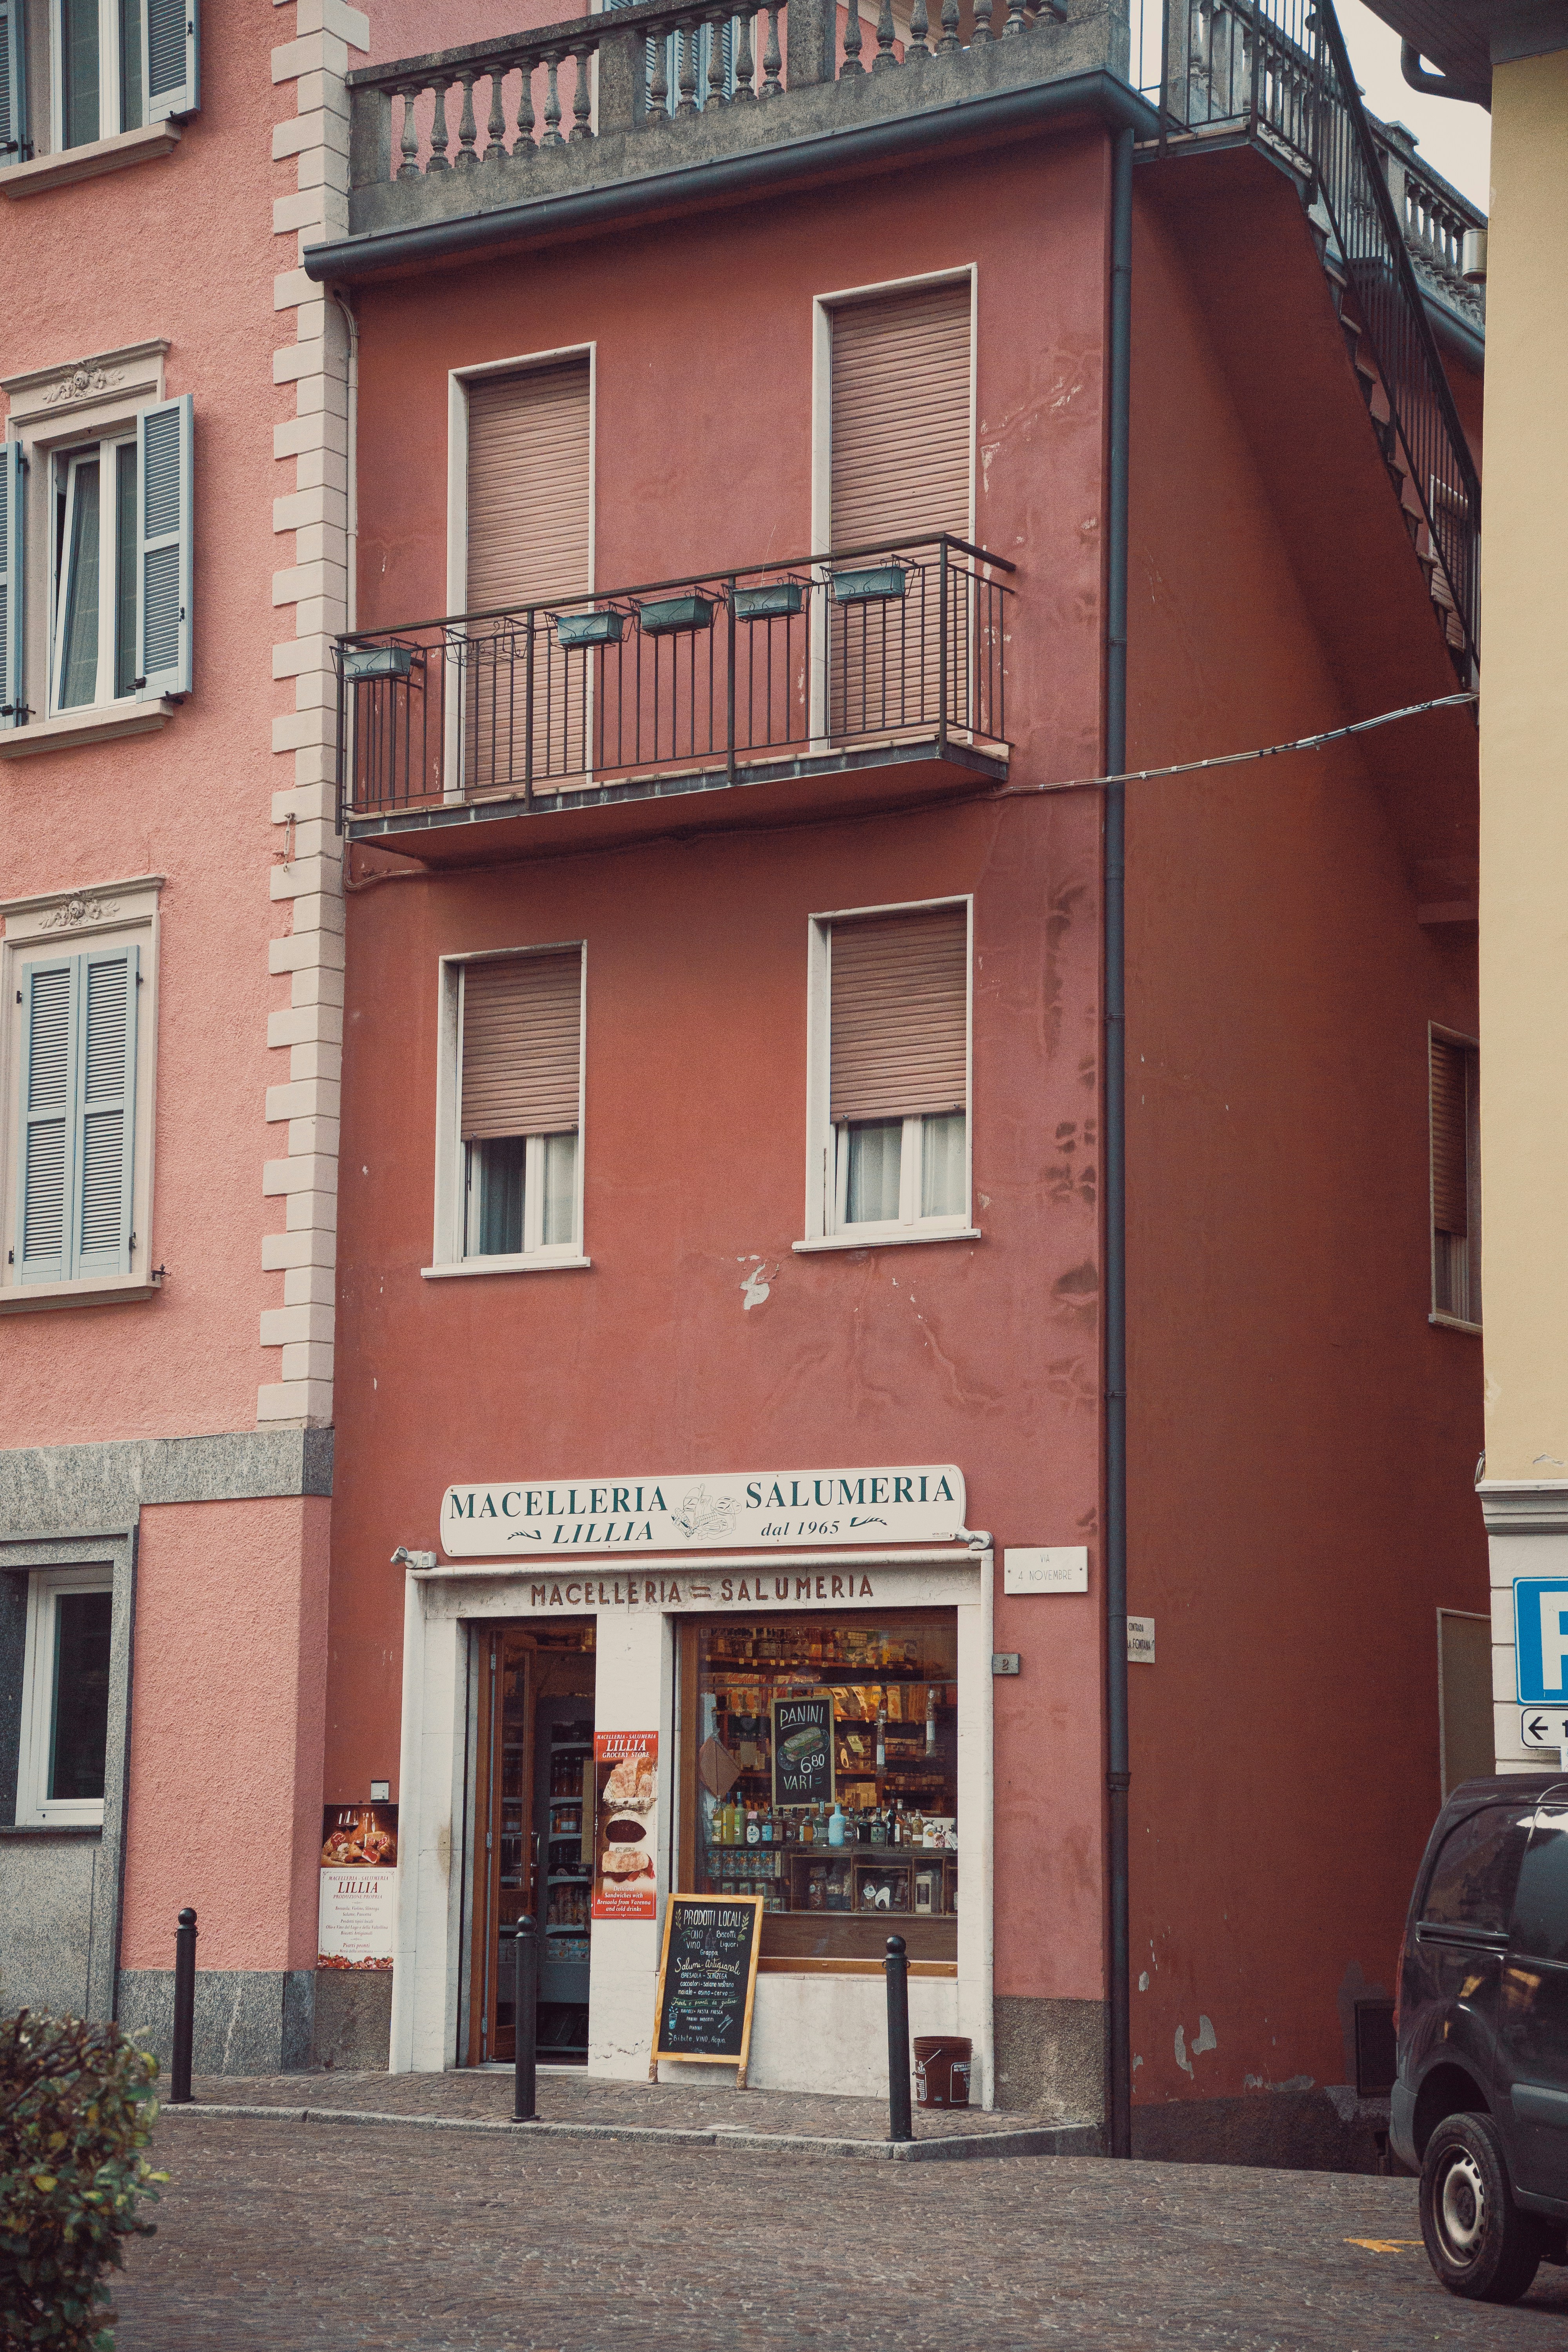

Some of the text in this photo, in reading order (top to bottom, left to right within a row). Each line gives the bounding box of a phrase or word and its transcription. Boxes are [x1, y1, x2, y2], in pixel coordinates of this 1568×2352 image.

[449, 1475, 955, 1519] MACELLERIA SALUMERIA
[552, 1520, 840, 1544] LILLIA dal 1965
[1040, 1554, 1050, 1563] VIA
[1018, 1569, 1072, 1581] 4 NOVEMBRE
[530, 1574, 874, 1606] MACELLERIA SALUMERIA
[1129, 1622, 1144, 1633] CONTRADA
[1132, 1639, 1151, 1650] FONTANA
[1002, 1659, 1009, 1670] 2
[780, 1705, 824, 1727] PANINI
[606, 1739, 646, 1751] LILLIA
[784, 1775, 812, 1790] VARI
[338, 1882, 377, 1893] LILLIA
[684, 1909, 740, 1927] PRODOTTI LOCALI
[720, 1940, 738, 1952] Liquori
[700, 1949, 718, 1958] Grappa
[711, 2036, 726, 2047] Acqua
